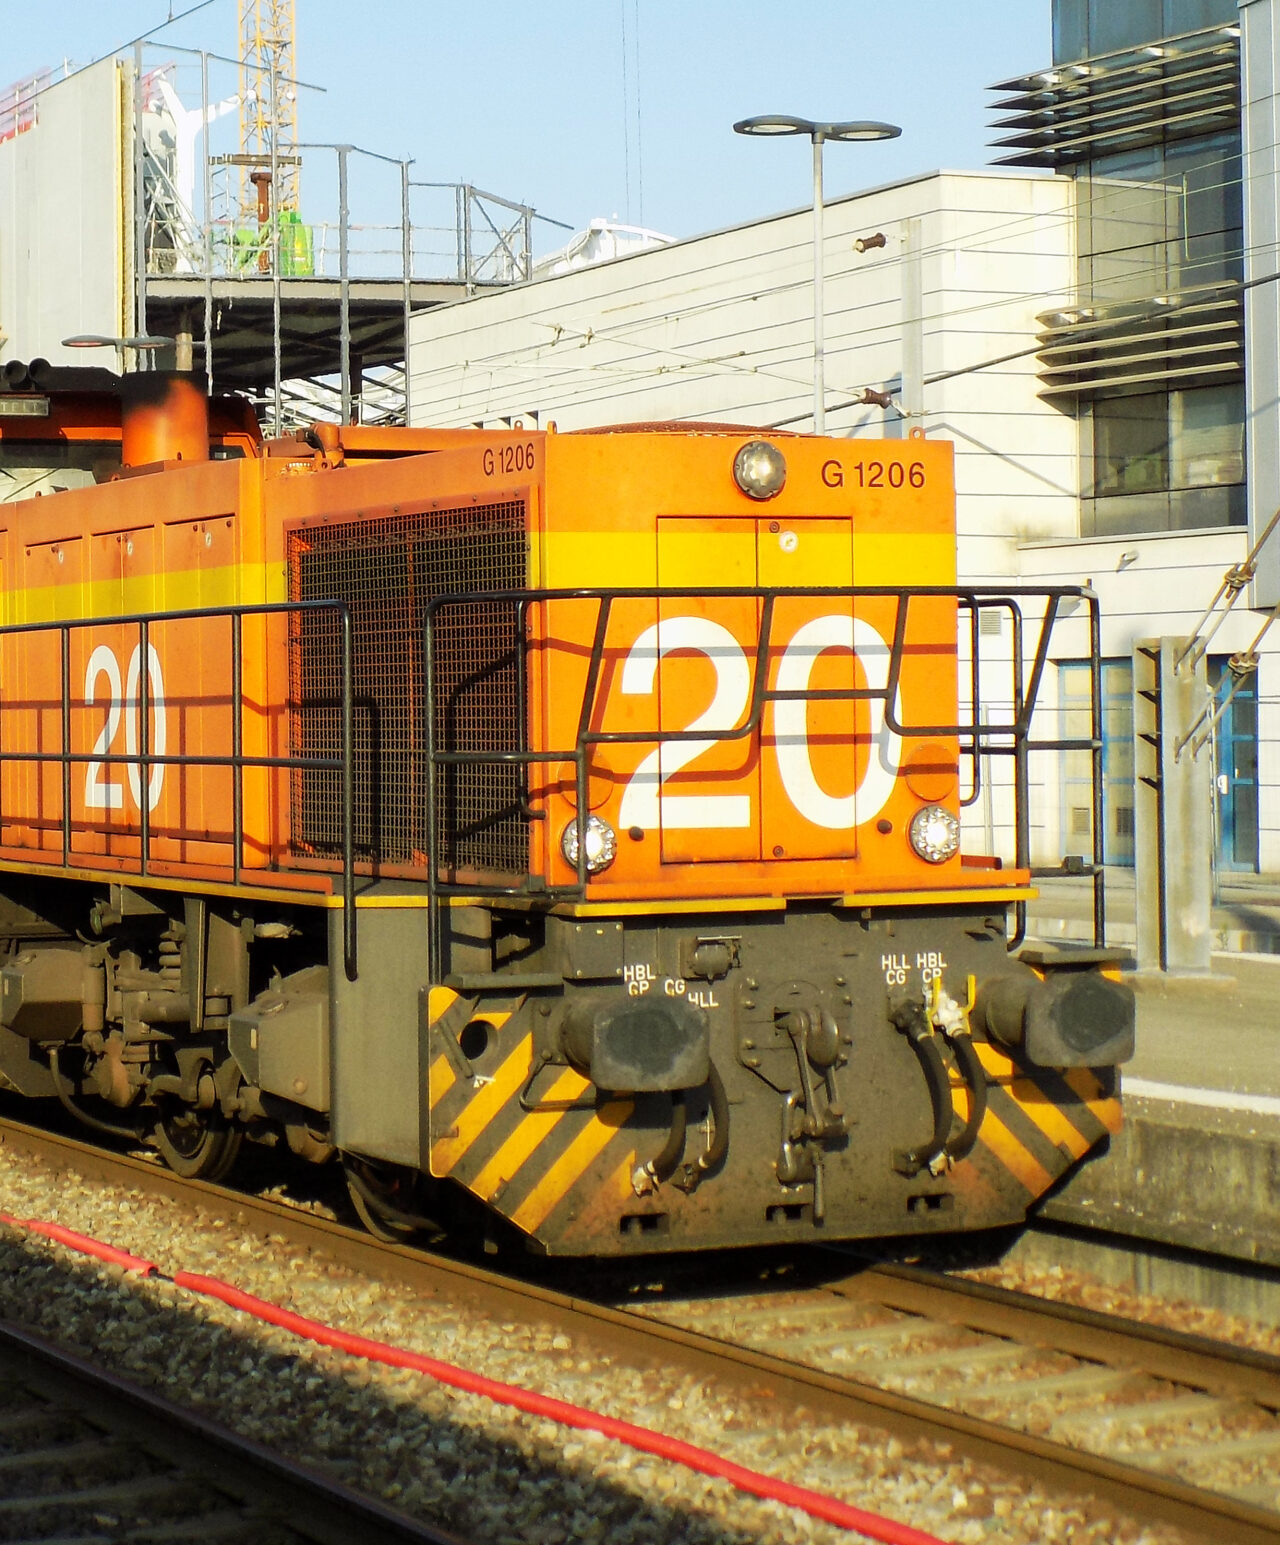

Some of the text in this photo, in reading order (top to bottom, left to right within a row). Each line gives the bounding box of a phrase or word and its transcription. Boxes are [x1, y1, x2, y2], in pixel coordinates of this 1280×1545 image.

[483, 442, 535, 476] G 1206
[821, 459, 926, 488] G 1206
[84, 641, 167, 813] 20
[618, 614, 903, 829] 20
[623, 963, 657, 982] HBL
[881, 952, 948, 970] HLL HBL
[664, 979, 686, 996] CG
[886, 969, 907, 985] CG
